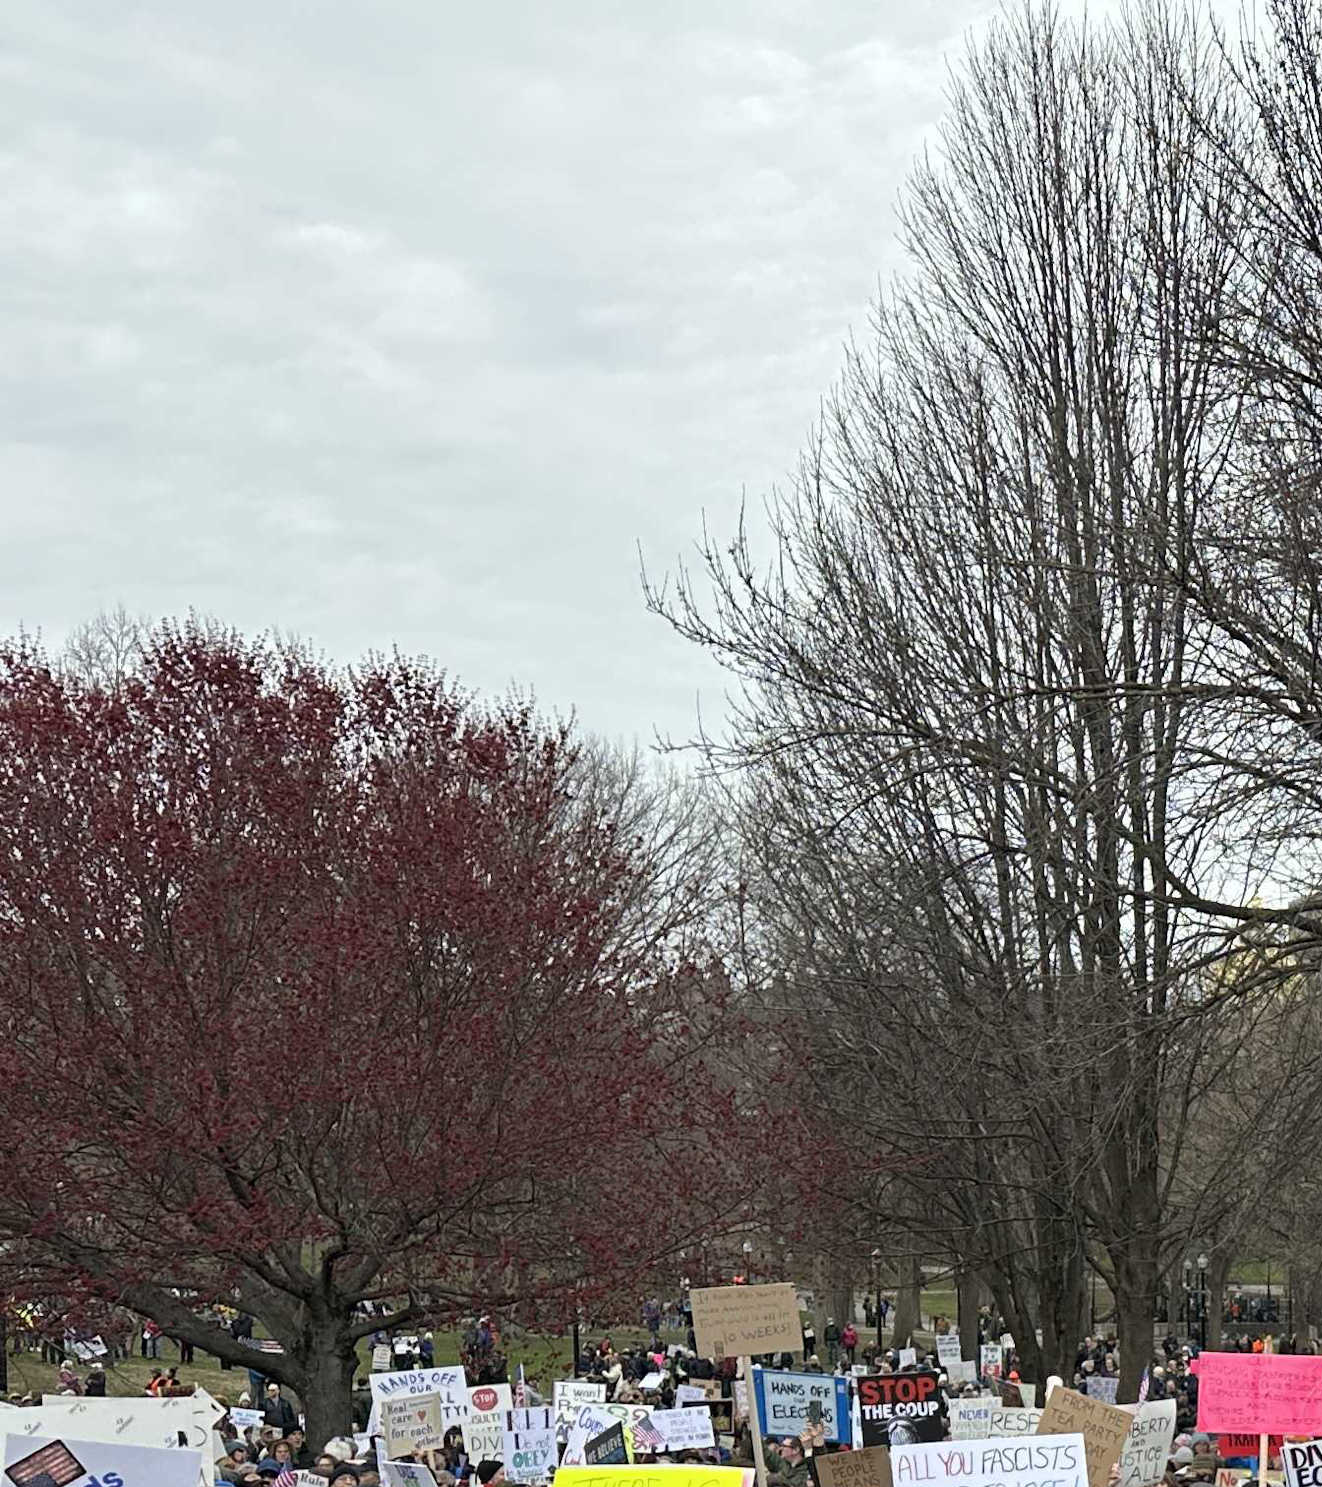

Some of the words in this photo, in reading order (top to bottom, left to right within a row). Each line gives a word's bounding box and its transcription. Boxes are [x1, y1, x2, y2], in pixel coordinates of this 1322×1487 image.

[377, 1373, 426, 1395] HANDS
[771, 1381, 806, 1398] HANDS
[810, 1382, 831, 1399] OFF
[861, 1376, 937, 1404] STOP
[862, 1403, 896, 1420] THE
[898, 1400, 940, 1419] COUP
[898, 1452, 936, 1484] ALL
[943, 1449, 974, 1478] YOU
[981, 1444, 1079, 1476] FASCISTS
